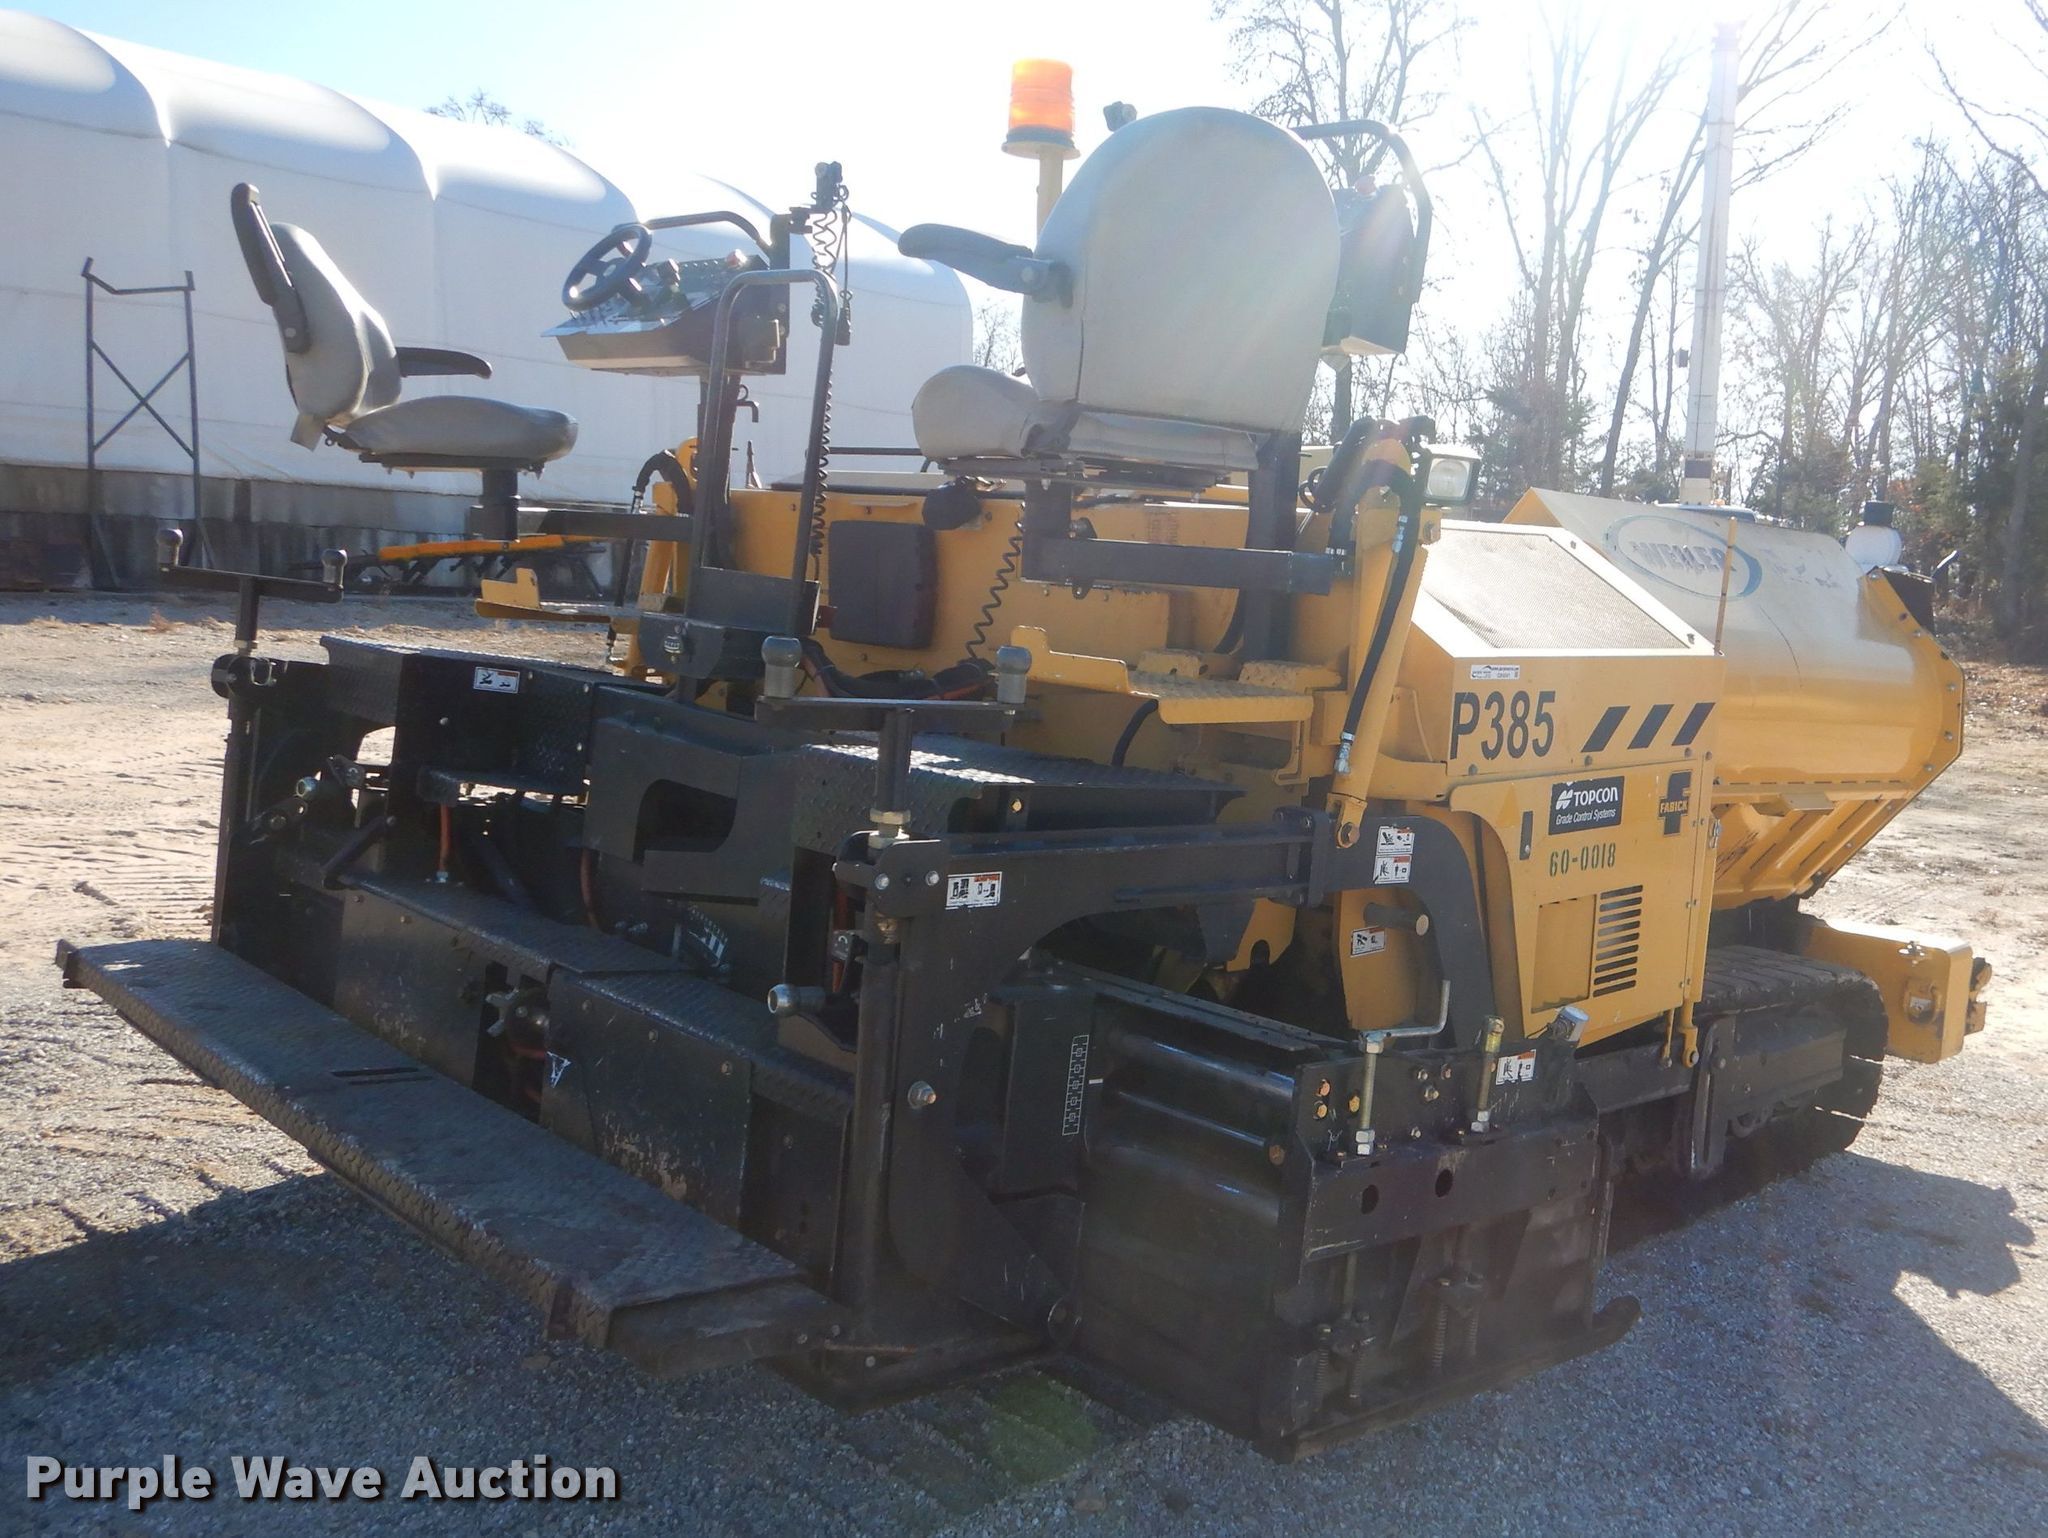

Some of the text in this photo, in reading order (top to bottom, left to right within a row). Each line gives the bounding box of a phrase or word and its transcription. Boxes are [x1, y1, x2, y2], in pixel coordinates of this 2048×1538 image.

[1450, 690, 1556, 760] P385
[1574, 787, 1619, 807] TOPCON
[1660, 800, 1688, 813] FABICK
[1555, 808, 1617, 825] Grade Control Systems
[1550, 843, 1616, 877] 60-0018
